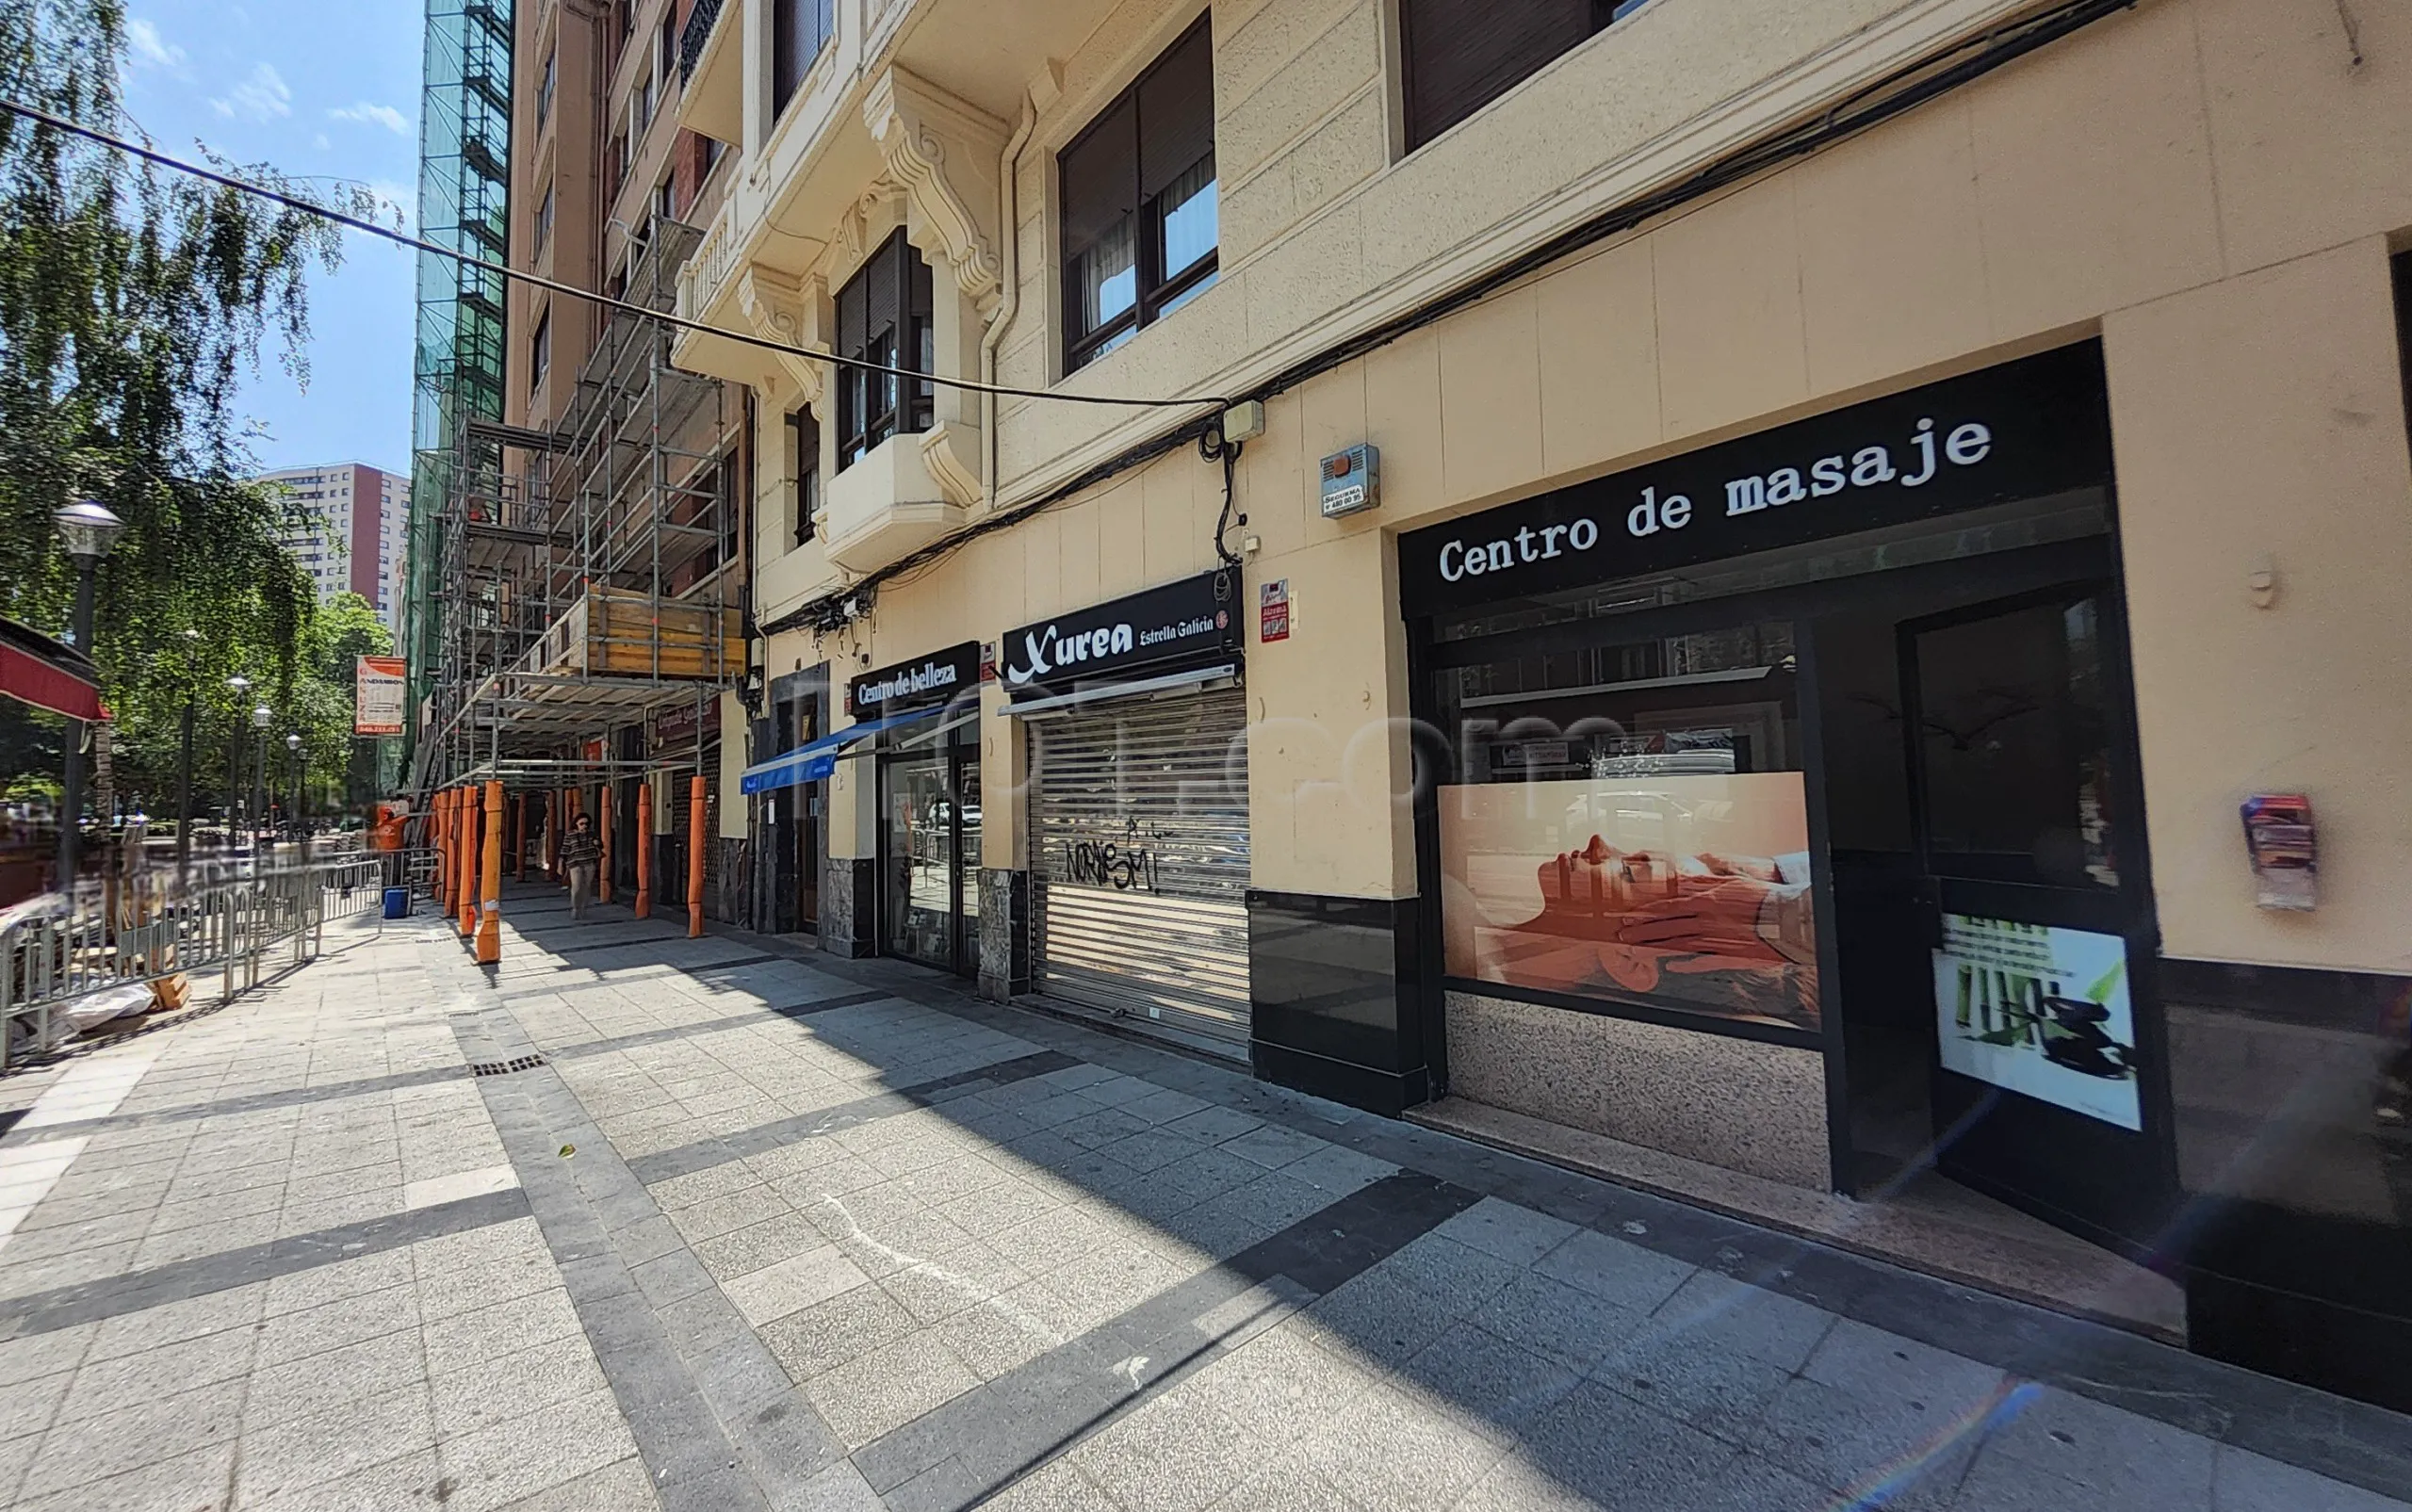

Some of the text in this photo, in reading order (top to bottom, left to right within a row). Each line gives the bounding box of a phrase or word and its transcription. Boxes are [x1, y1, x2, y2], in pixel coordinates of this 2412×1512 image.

[1438, 416, 1994, 582] Centro de masaje
[858, 662, 957, 706] Centro de belleza
[1007, 615, 1214, 685] Xurea Estrella Galicia
